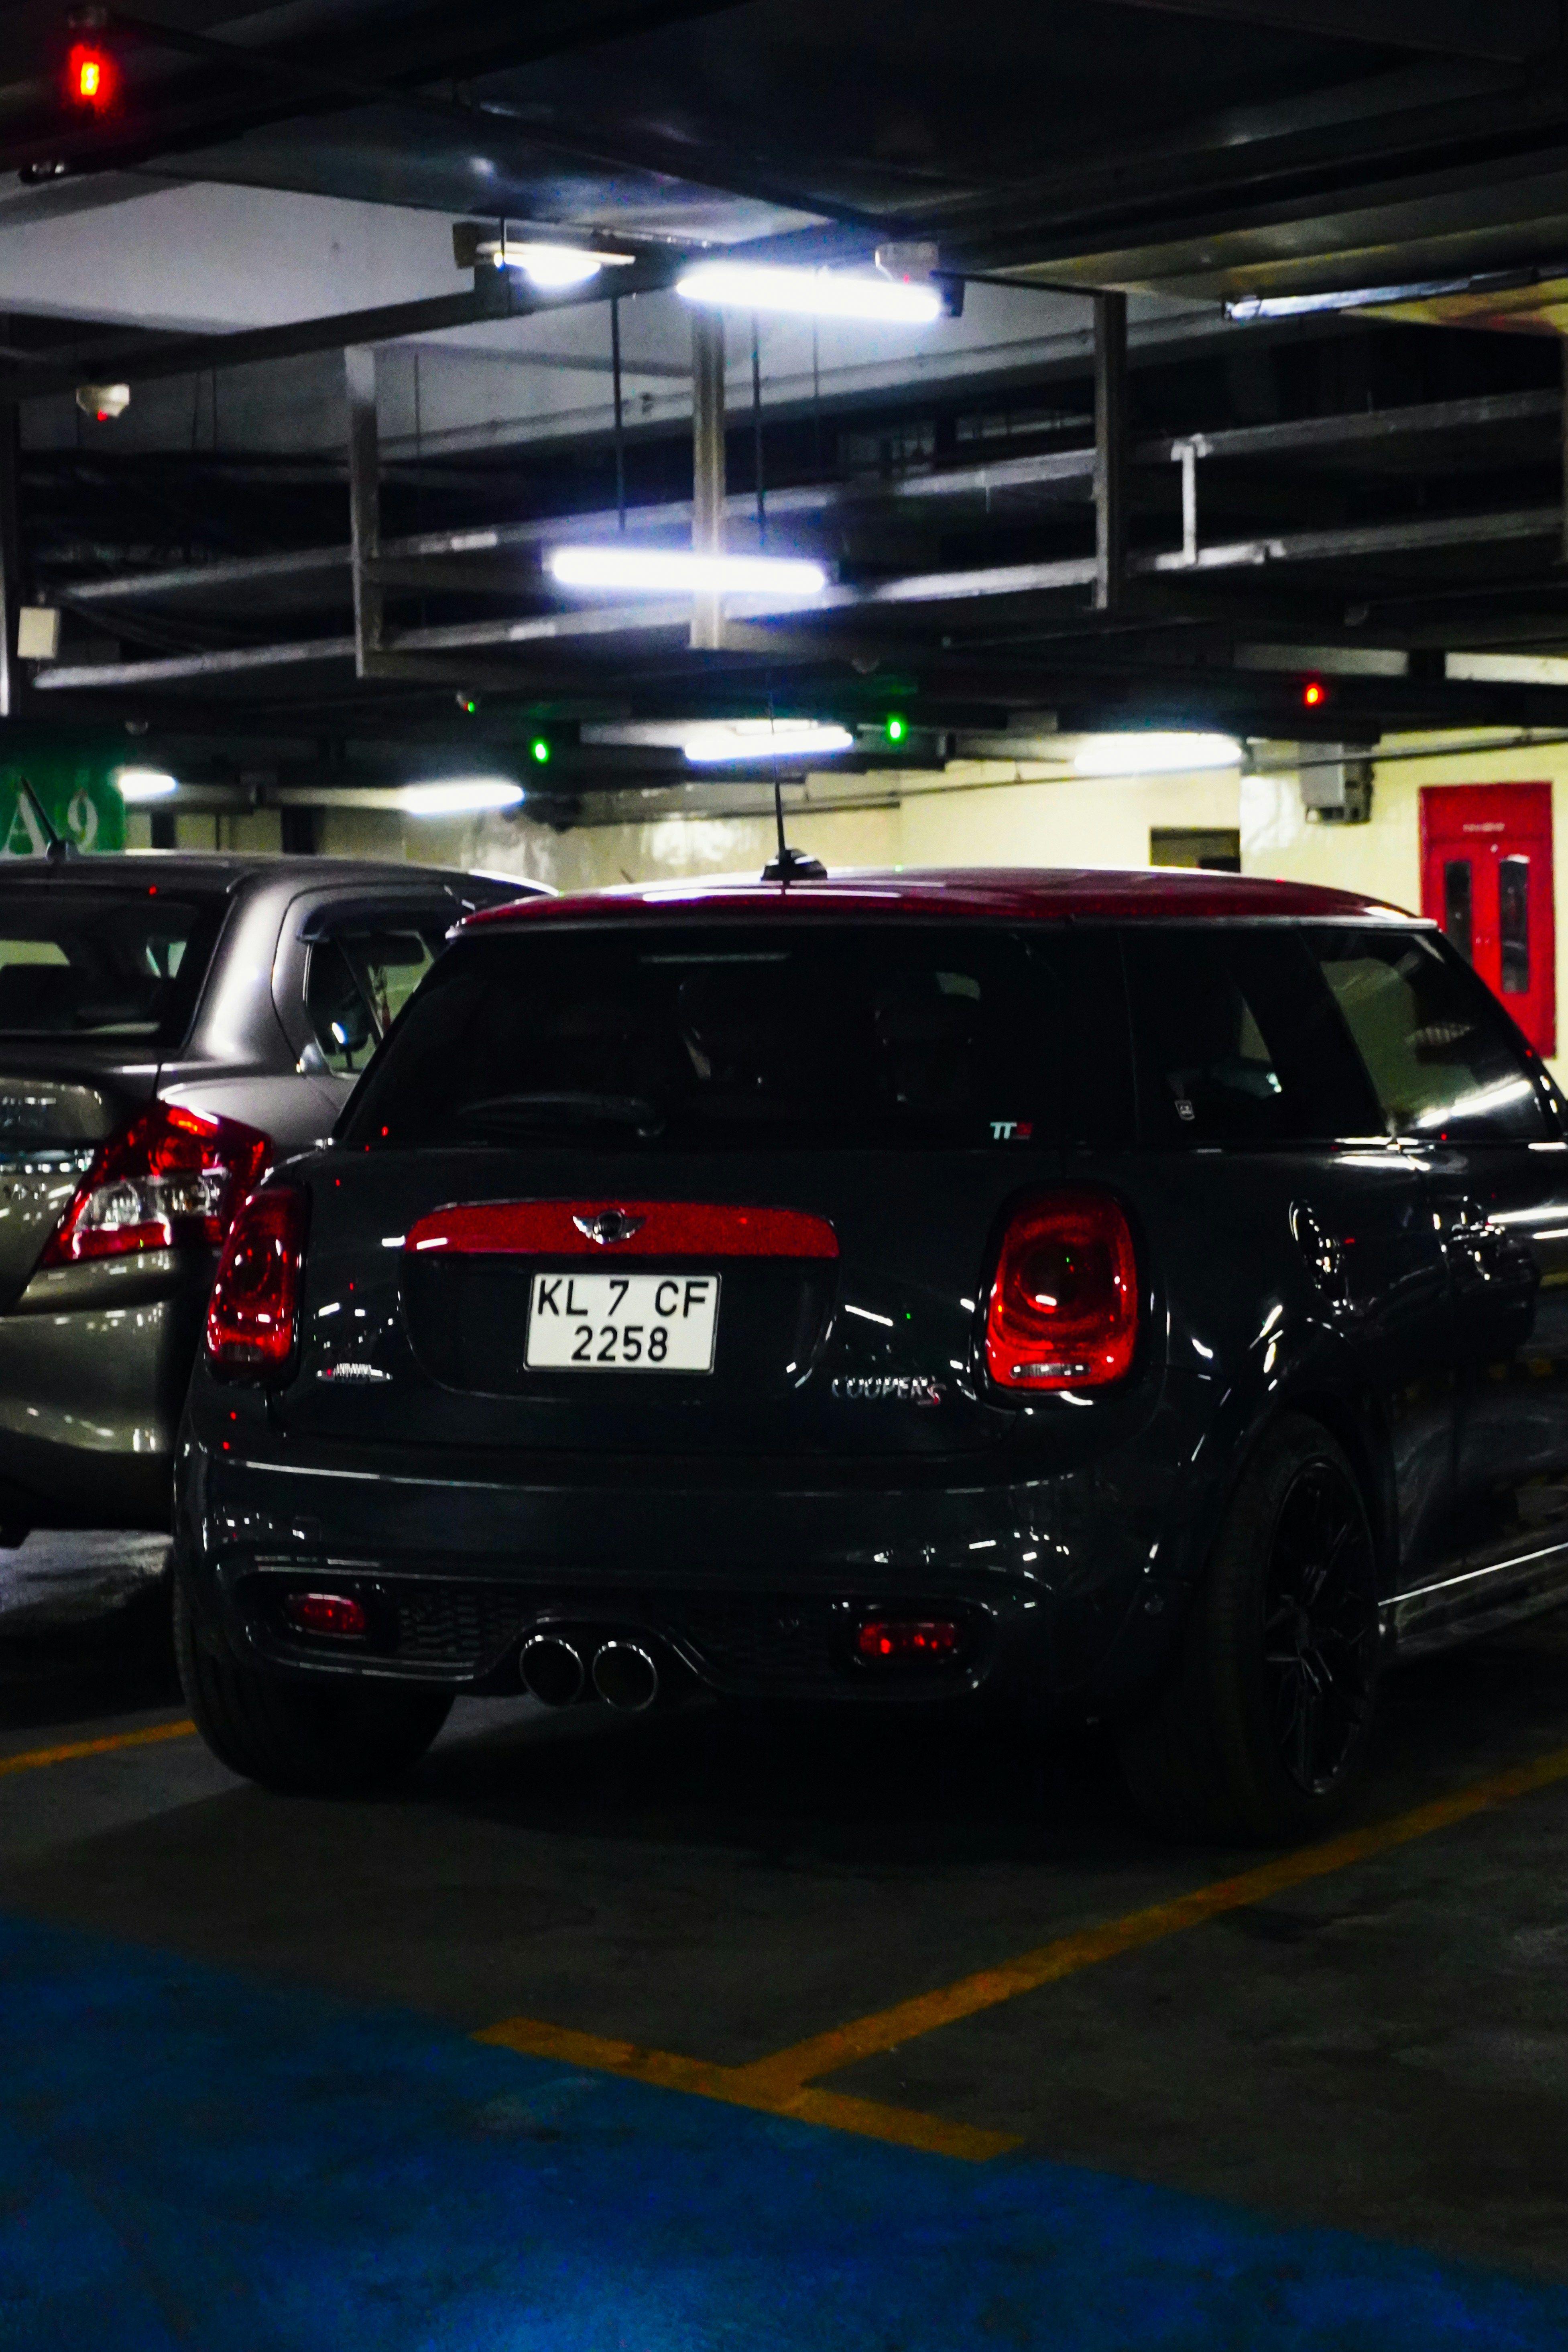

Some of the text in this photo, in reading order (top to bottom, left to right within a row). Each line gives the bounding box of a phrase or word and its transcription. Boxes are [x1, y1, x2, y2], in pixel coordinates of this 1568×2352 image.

[538, 1280, 709, 1318] KL 7 CF
[572, 1325, 668, 1362] 2258
